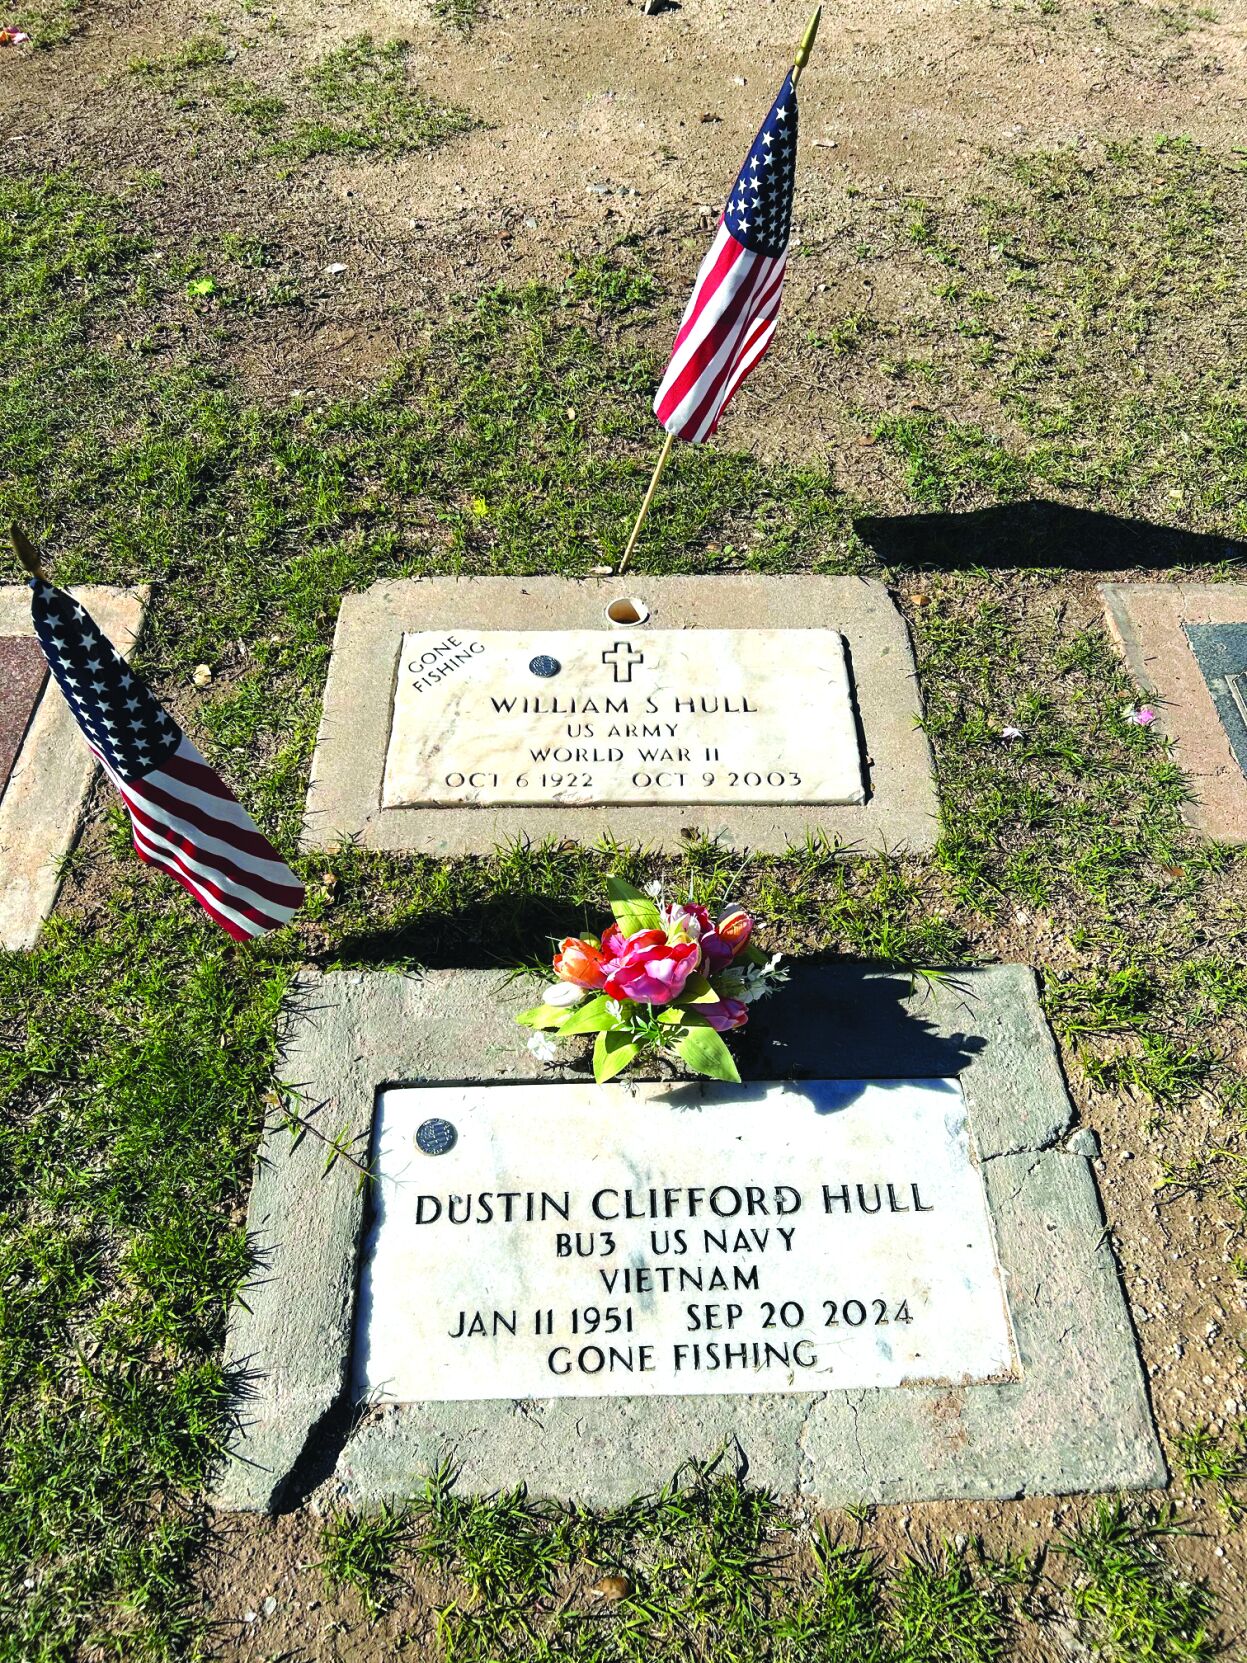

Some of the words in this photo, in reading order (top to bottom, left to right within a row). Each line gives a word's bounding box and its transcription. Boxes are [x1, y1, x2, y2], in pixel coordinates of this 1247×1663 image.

[408, 635, 462, 673] GONE
[412, 641, 485, 693] FISHING
[490, 697, 629, 714] WILLIAM
[646, 696, 659, 714] S
[675, 695, 758, 713] HULL
[567, 723, 595, 738] US
[607, 723, 679, 738] ARMY
[529, 747, 624, 762] WORLD
[637, 747, 692, 762] WAR
[444, 772, 499, 788] OCT
[516, 772, 530, 788] 6
[541, 772, 593, 787] 1922
[631, 772, 687, 788] OCT
[702, 771, 715, 788] 9
[728, 771, 803, 787] 2003
[415, 1191, 570, 1225] DUSTIN
[591, 1186, 801, 1220] CLIFFORD
[822, 1183, 934, 1214] HULL
[556, 1231, 616, 1258] BU3
[650, 1230, 689, 1255] US
[704, 1227, 796, 1253] NAVY
[599, 1265, 760, 1295] VIETNAM
[447, 1310, 517, 1339] JAN
[571, 1307, 634, 1335] 1951
[686, 1303, 743, 1332] SEP
[760, 1301, 804, 1329] 20
[822, 1298, 914, 1327] 2024
[547, 1345, 656, 1375] GONE
[673, 1339, 818, 1371] FISHING
